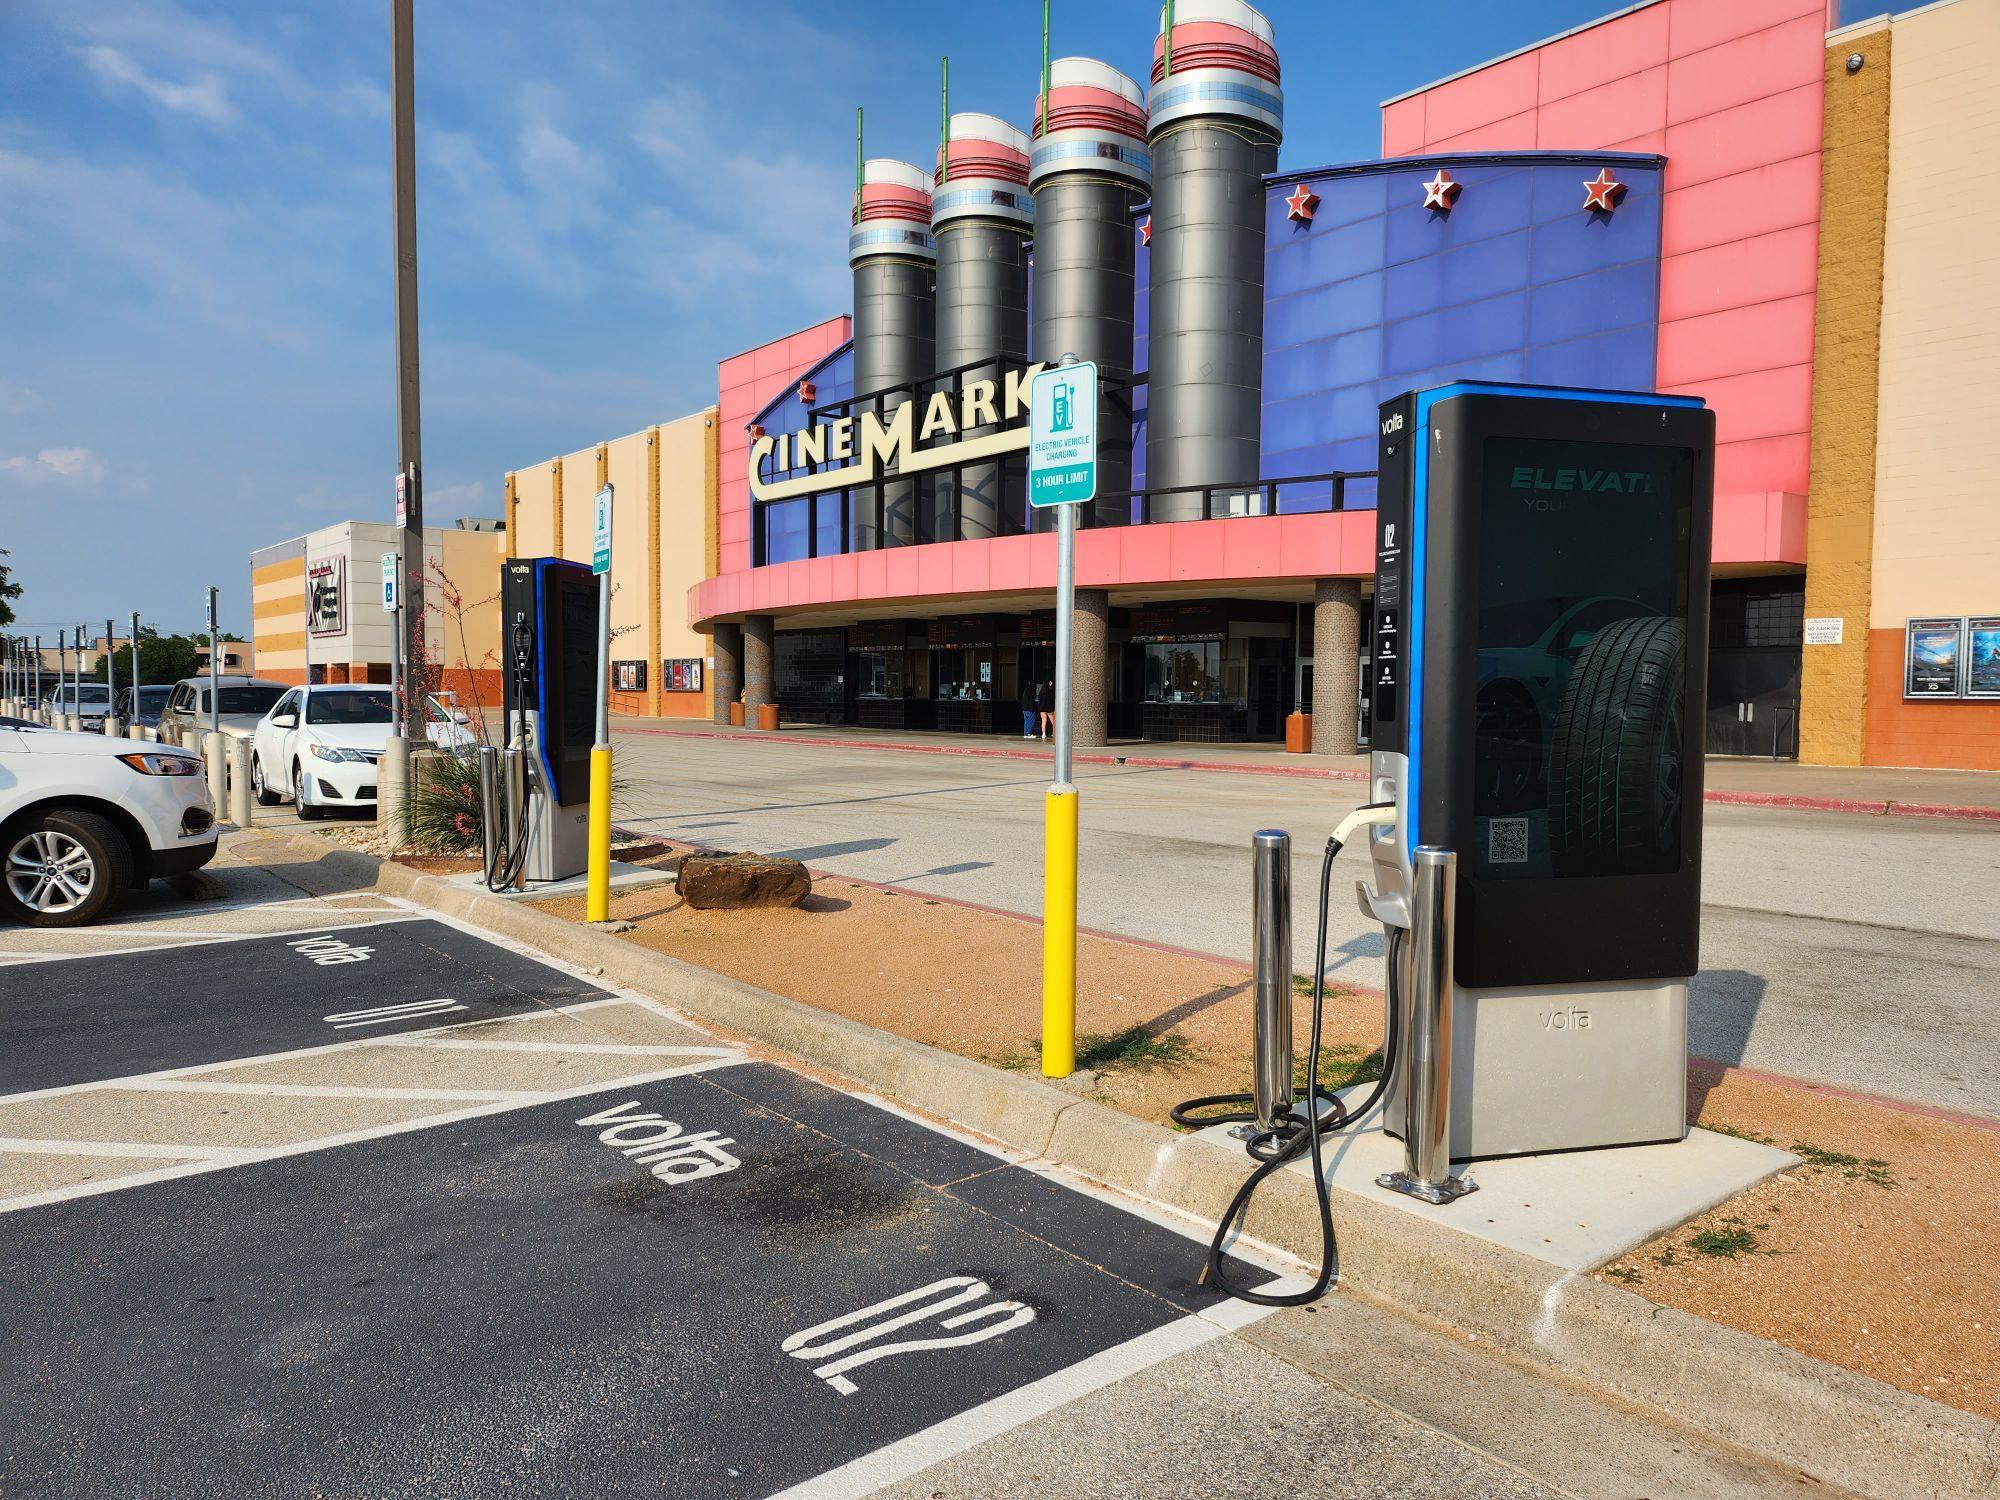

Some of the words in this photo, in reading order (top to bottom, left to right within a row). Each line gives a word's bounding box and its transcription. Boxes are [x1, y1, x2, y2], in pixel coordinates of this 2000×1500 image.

[749, 361, 1047, 502] CINEMARK
[1381, 412, 1404, 436] volta
[1035, 439, 1063, 452] ELECTRIC
[1064, 435, 1090, 447] VEHICLE
[1047, 449, 1078, 461] CHARGING
[1035, 477, 1041, 488] 3
[1042, 474, 1065, 487] HOUR
[1066, 471, 1089, 485] LIMIT
[1384, 523, 1395, 548] 02
[510, 564, 530, 574] volta
[286, 935, 376, 966] volta
[1539, 1005, 1593, 1032] volta
[576, 1100, 741, 1186] volta
[781, 1275, 1038, 1397] 02
